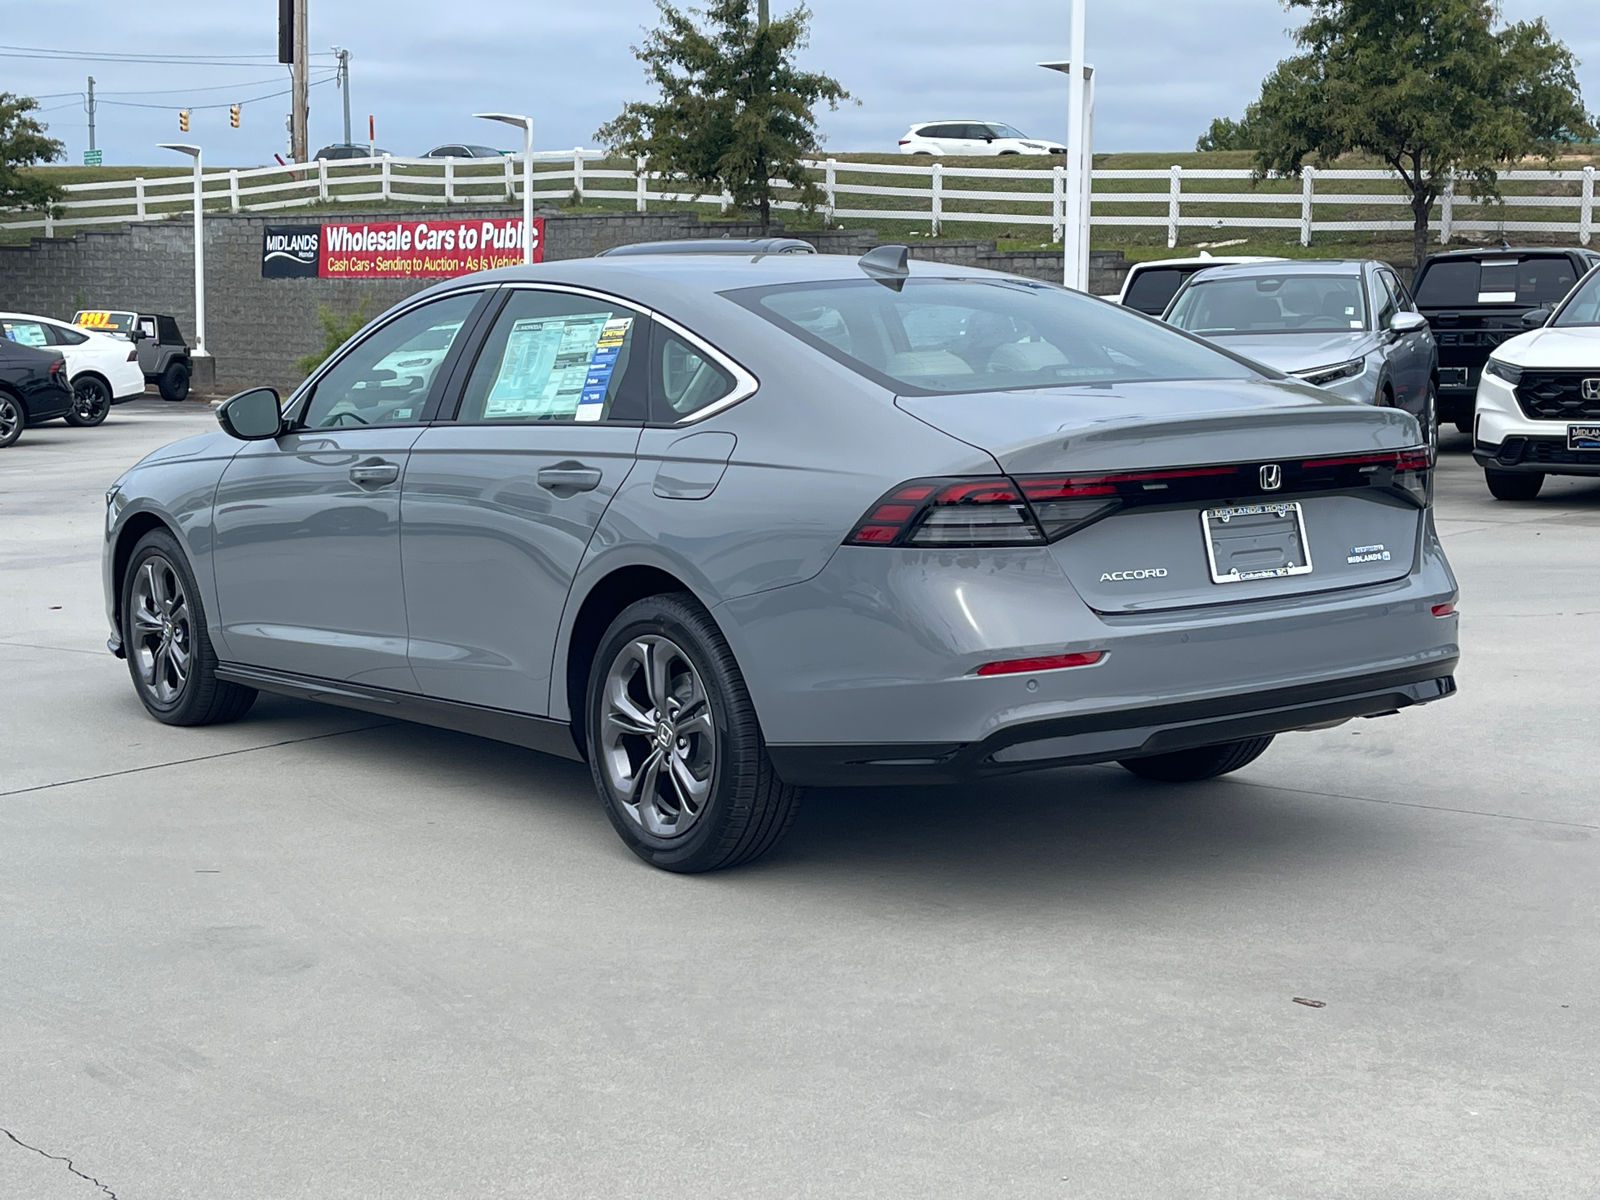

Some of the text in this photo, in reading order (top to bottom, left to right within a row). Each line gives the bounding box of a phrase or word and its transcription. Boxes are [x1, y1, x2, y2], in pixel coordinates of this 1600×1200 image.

[266, 234, 318, 251] MIDLANDS
[326, 224, 411, 251] Wholesale
[414, 223, 456, 250] Cars
[458, 224, 478, 250] to
[328, 257, 348, 272] Cash
[350, 256, 370, 272] Cars
[376, 256, 411, 274] Sending
[413, 257, 422, 271] to
[423, 256, 459, 271] Auction
[465, 255, 478, 271] As
[480, 255, 488, 271] Is
[1214, 503, 1296, 517] MIDLANDS HONDA
[1099, 568, 1168, 582] ACCORD
